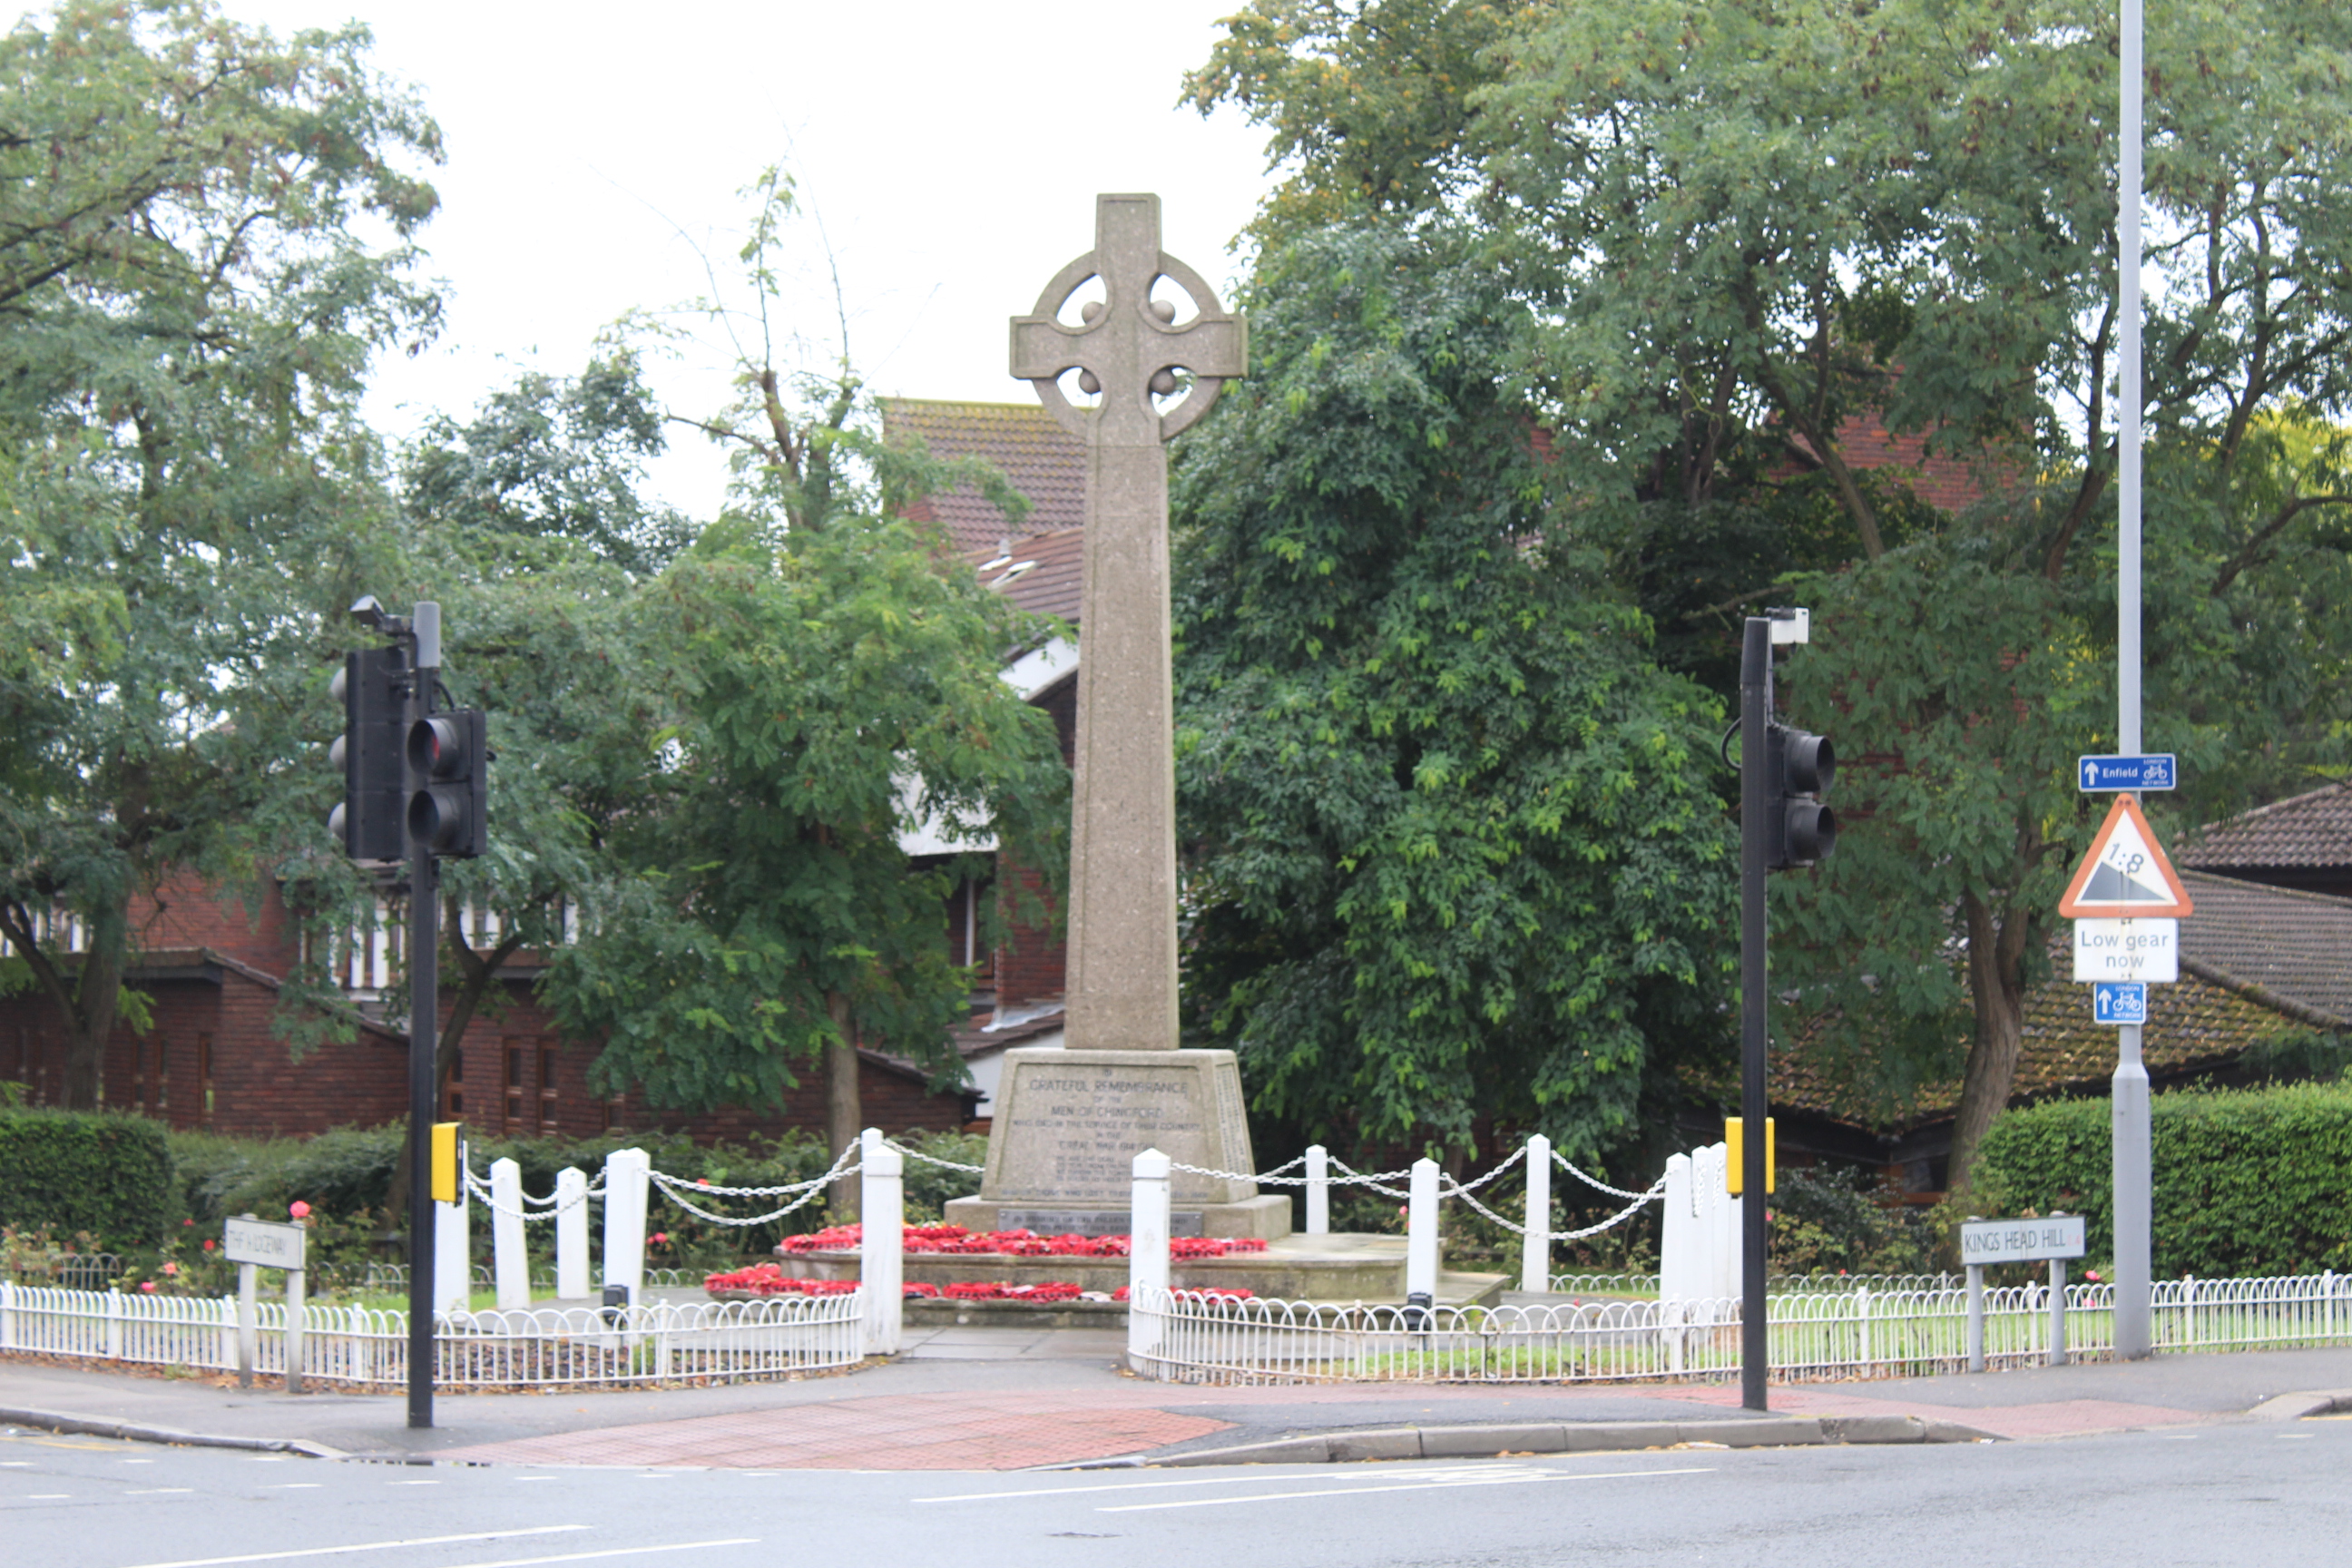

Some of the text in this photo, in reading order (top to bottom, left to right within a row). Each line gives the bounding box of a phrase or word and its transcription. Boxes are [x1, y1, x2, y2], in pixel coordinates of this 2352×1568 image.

[2102, 767, 2138, 779] Enfield
[2108, 843, 2144, 873] 1:8
[2081, 930, 2169, 950] Low gear
[2105, 954, 2144, 968] now
[1029, 1079, 1089, 1092] GRATEFUL
[1051, 1106, 1074, 1116] MEN
[1965, 1231, 2001, 1253] KINGS
[2004, 1230, 2038, 1250] HEAD
[2041, 1228, 2066, 1249] HILL
